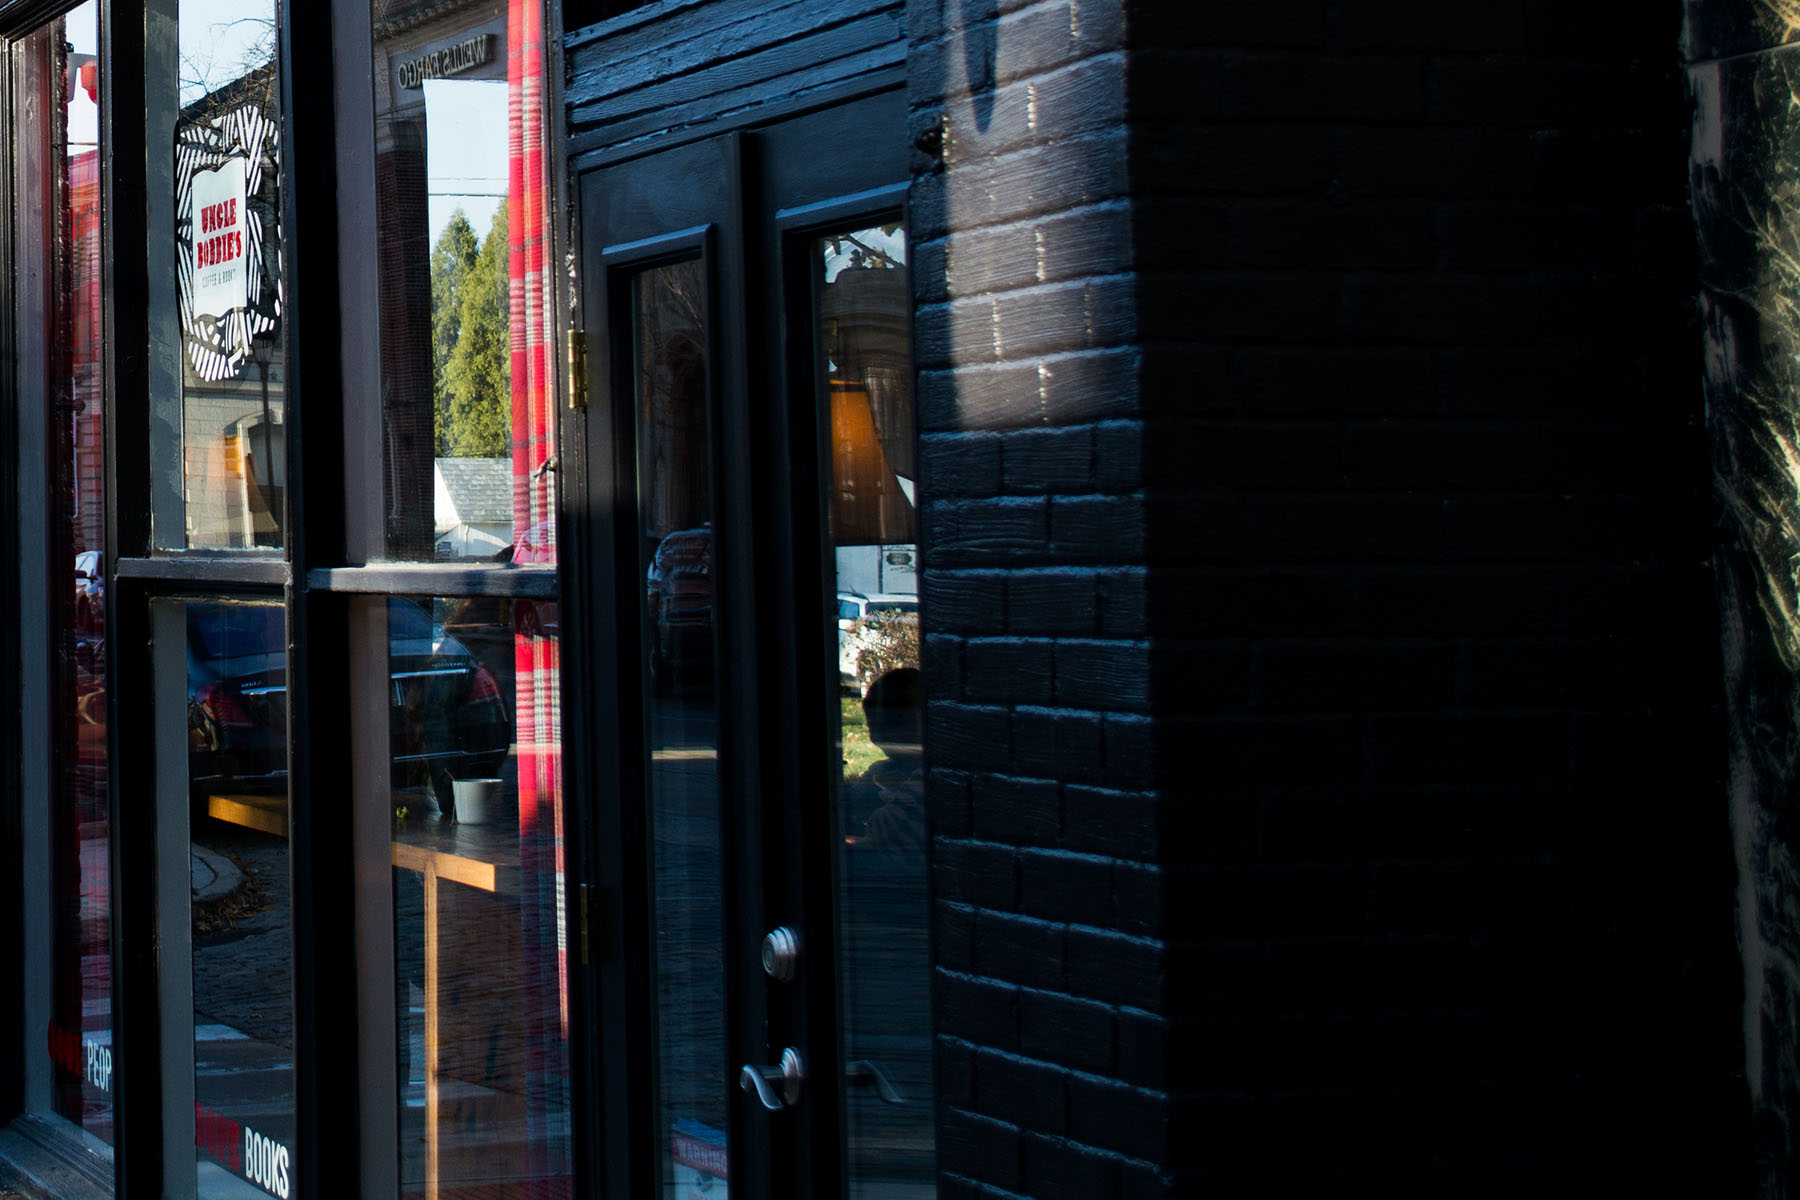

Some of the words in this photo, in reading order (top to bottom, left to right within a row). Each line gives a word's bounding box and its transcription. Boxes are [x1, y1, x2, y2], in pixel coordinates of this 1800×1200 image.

[200, 197, 236, 234] UNCLE
[196, 230, 242, 270] BOBBIE'S
[245, 1125, 290, 1200] BOOKS
